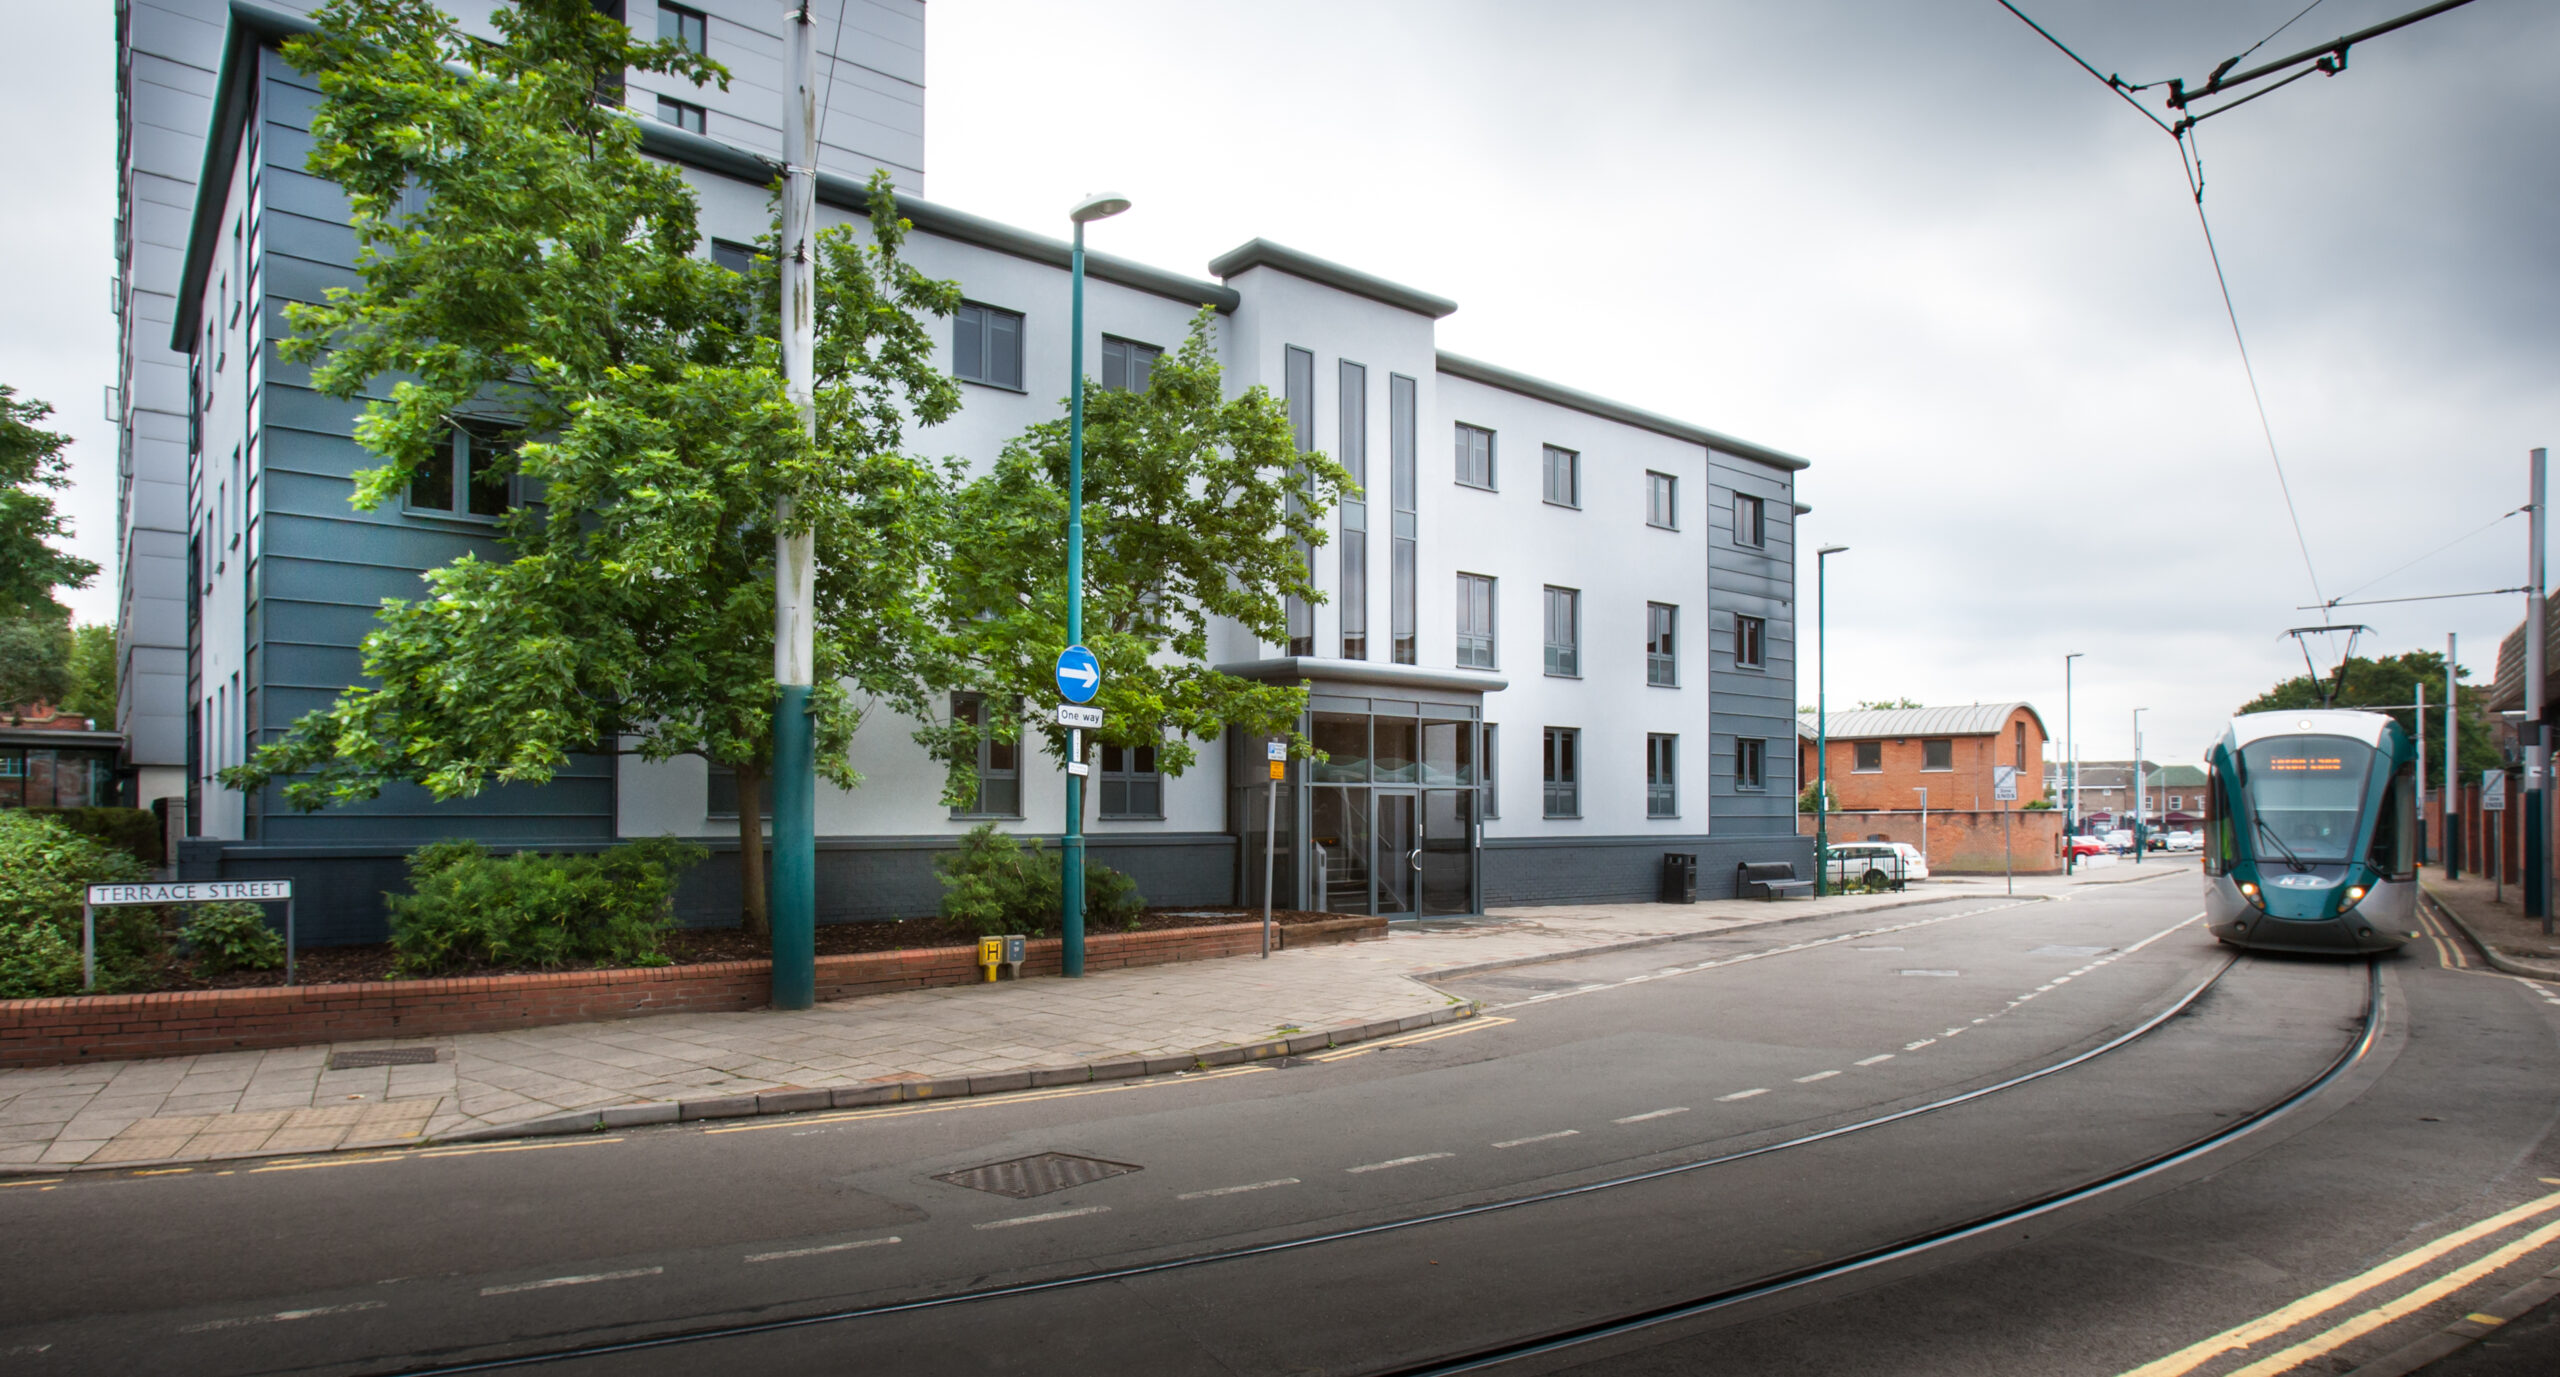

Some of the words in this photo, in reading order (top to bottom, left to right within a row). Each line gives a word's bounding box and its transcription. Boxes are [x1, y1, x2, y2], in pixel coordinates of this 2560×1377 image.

[1061, 709, 1079, 721] One
[1083, 714, 1100, 724] way
[97, 885, 197, 902] TERRACE
[208, 882, 285, 898] STREET
[987, 943, 999, 961] H
